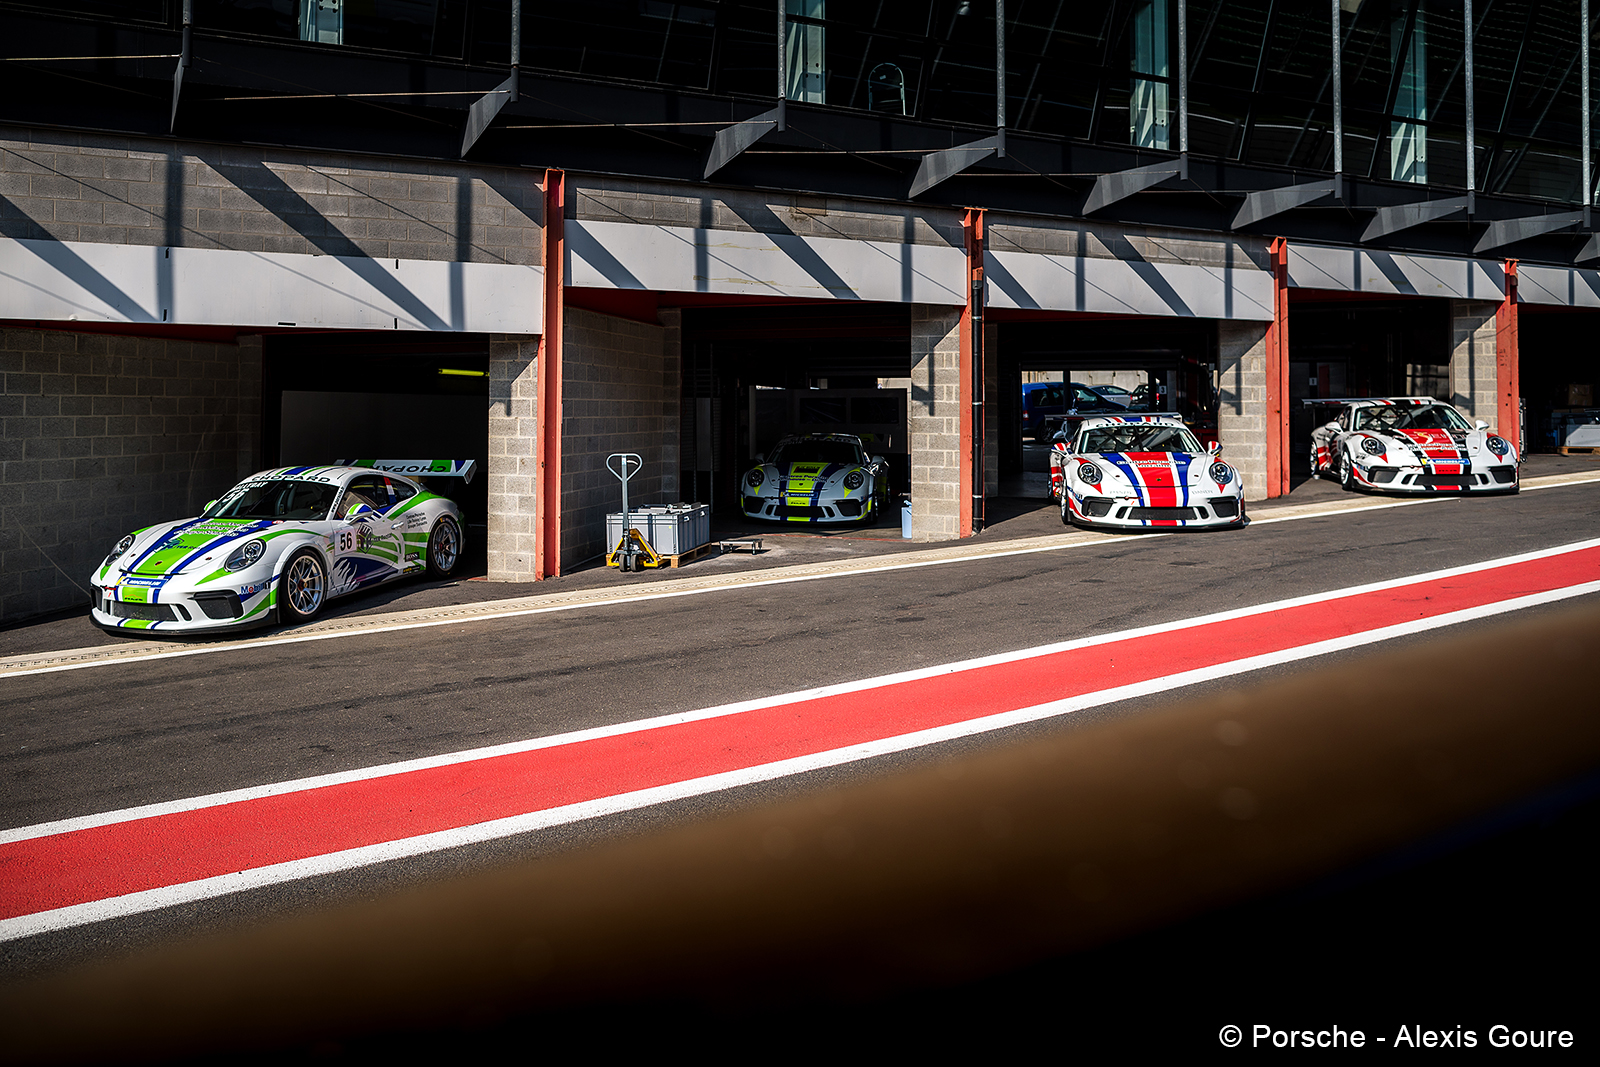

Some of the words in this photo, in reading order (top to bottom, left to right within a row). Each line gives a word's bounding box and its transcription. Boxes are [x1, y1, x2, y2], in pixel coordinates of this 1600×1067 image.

[251, 474, 332, 483] CHOPARD
[339, 531, 353, 552] 56
[240, 583, 265, 595] Mobil
